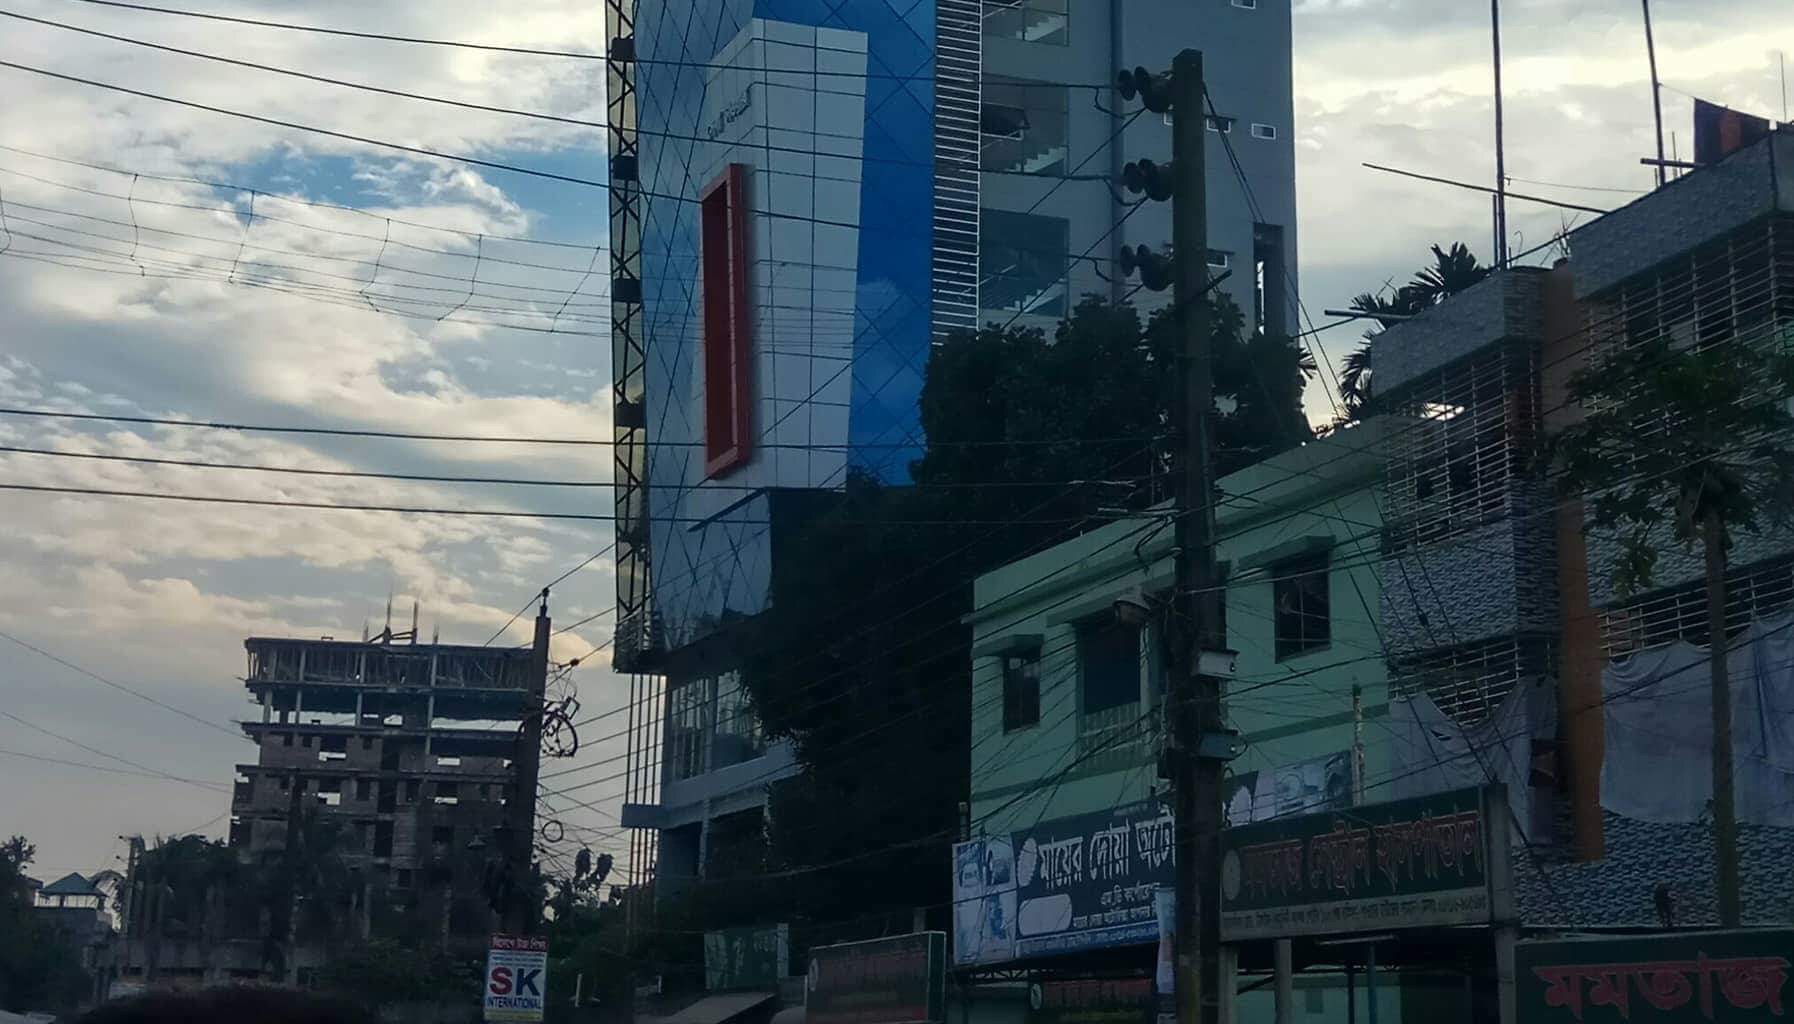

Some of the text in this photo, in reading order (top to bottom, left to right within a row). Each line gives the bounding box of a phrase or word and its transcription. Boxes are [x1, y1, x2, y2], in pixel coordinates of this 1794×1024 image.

[490, 967, 541, 996] SK
[1531, 949, 1792, 1021] মমতাজ
[486, 996, 542, 1009] INTERNATIONAL
